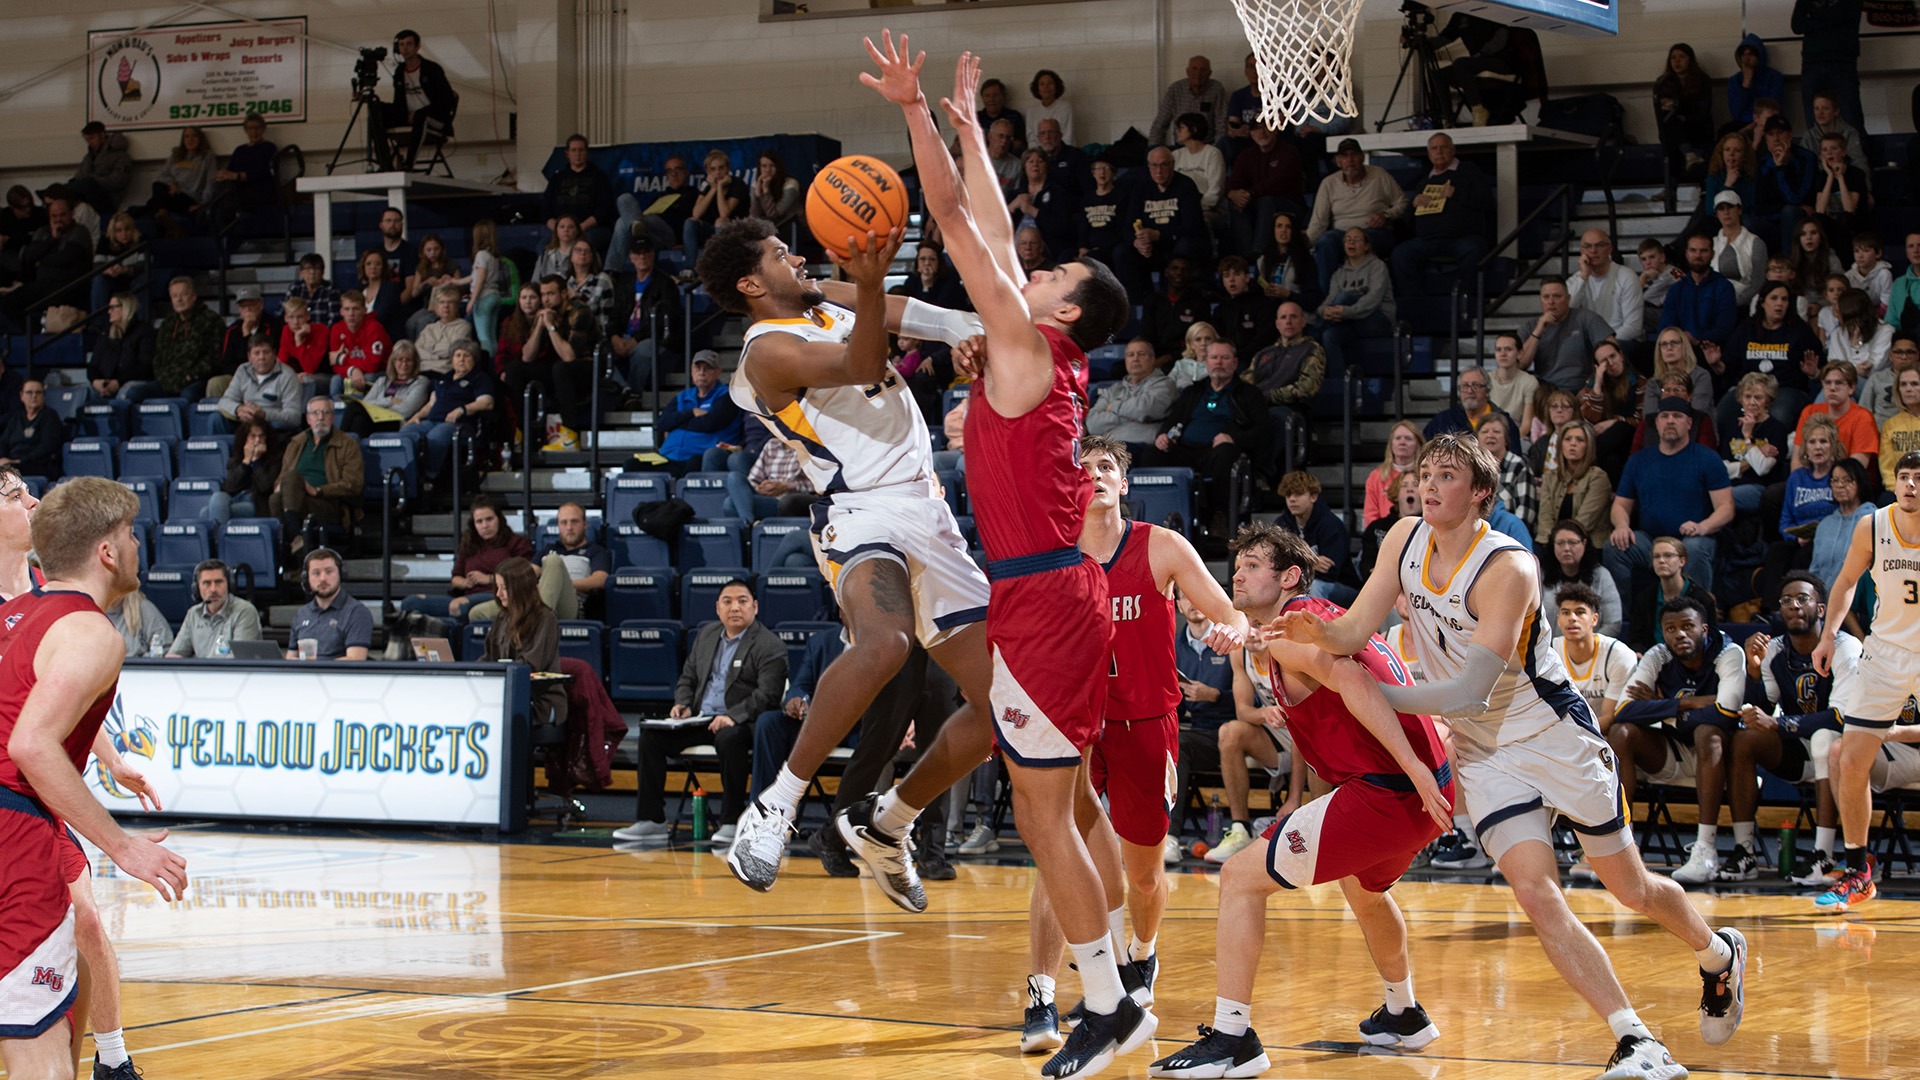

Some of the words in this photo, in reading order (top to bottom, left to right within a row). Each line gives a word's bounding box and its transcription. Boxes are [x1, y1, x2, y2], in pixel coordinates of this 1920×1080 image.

[175, 33, 222, 45] Appetizers
[229, 37, 254, 48] Juicy
[257, 35, 295, 47] Burgers
[166, 53, 188, 64] Subs
[201, 51, 231, 62] Wraps
[241, 53, 283, 65] Desserts
[169, 99, 293, 119] 937-766-2046
[851, 160, 892, 193] NCAA
[825, 172, 877, 225] Wilson
[1747, 341, 1790, 351] CEDARVILLE
[1746, 349, 1789, 360] BASKETBALL
[140, 404, 170, 413] RESERVED
[71, 443, 100, 451] RESERVED
[127, 442, 160, 450] RESERVED
[187, 441, 217, 450] RESERVED
[369, 439, 401, 447] RESERVED
[618, 479, 653, 488] RESERVED
[1133, 475, 1174, 484] RESERVED
[148, 572, 181, 581] RESERVED
[768, 576, 807, 585] RESERVED
[562, 628, 589, 637] ERVED
[1002, 706, 1031, 729] MU
[167, 712, 316, 770] YELLOW
[320, 718, 490, 781] JACKETS
[1285, 829, 1308, 854] MU
[31, 966, 64, 992] MU
